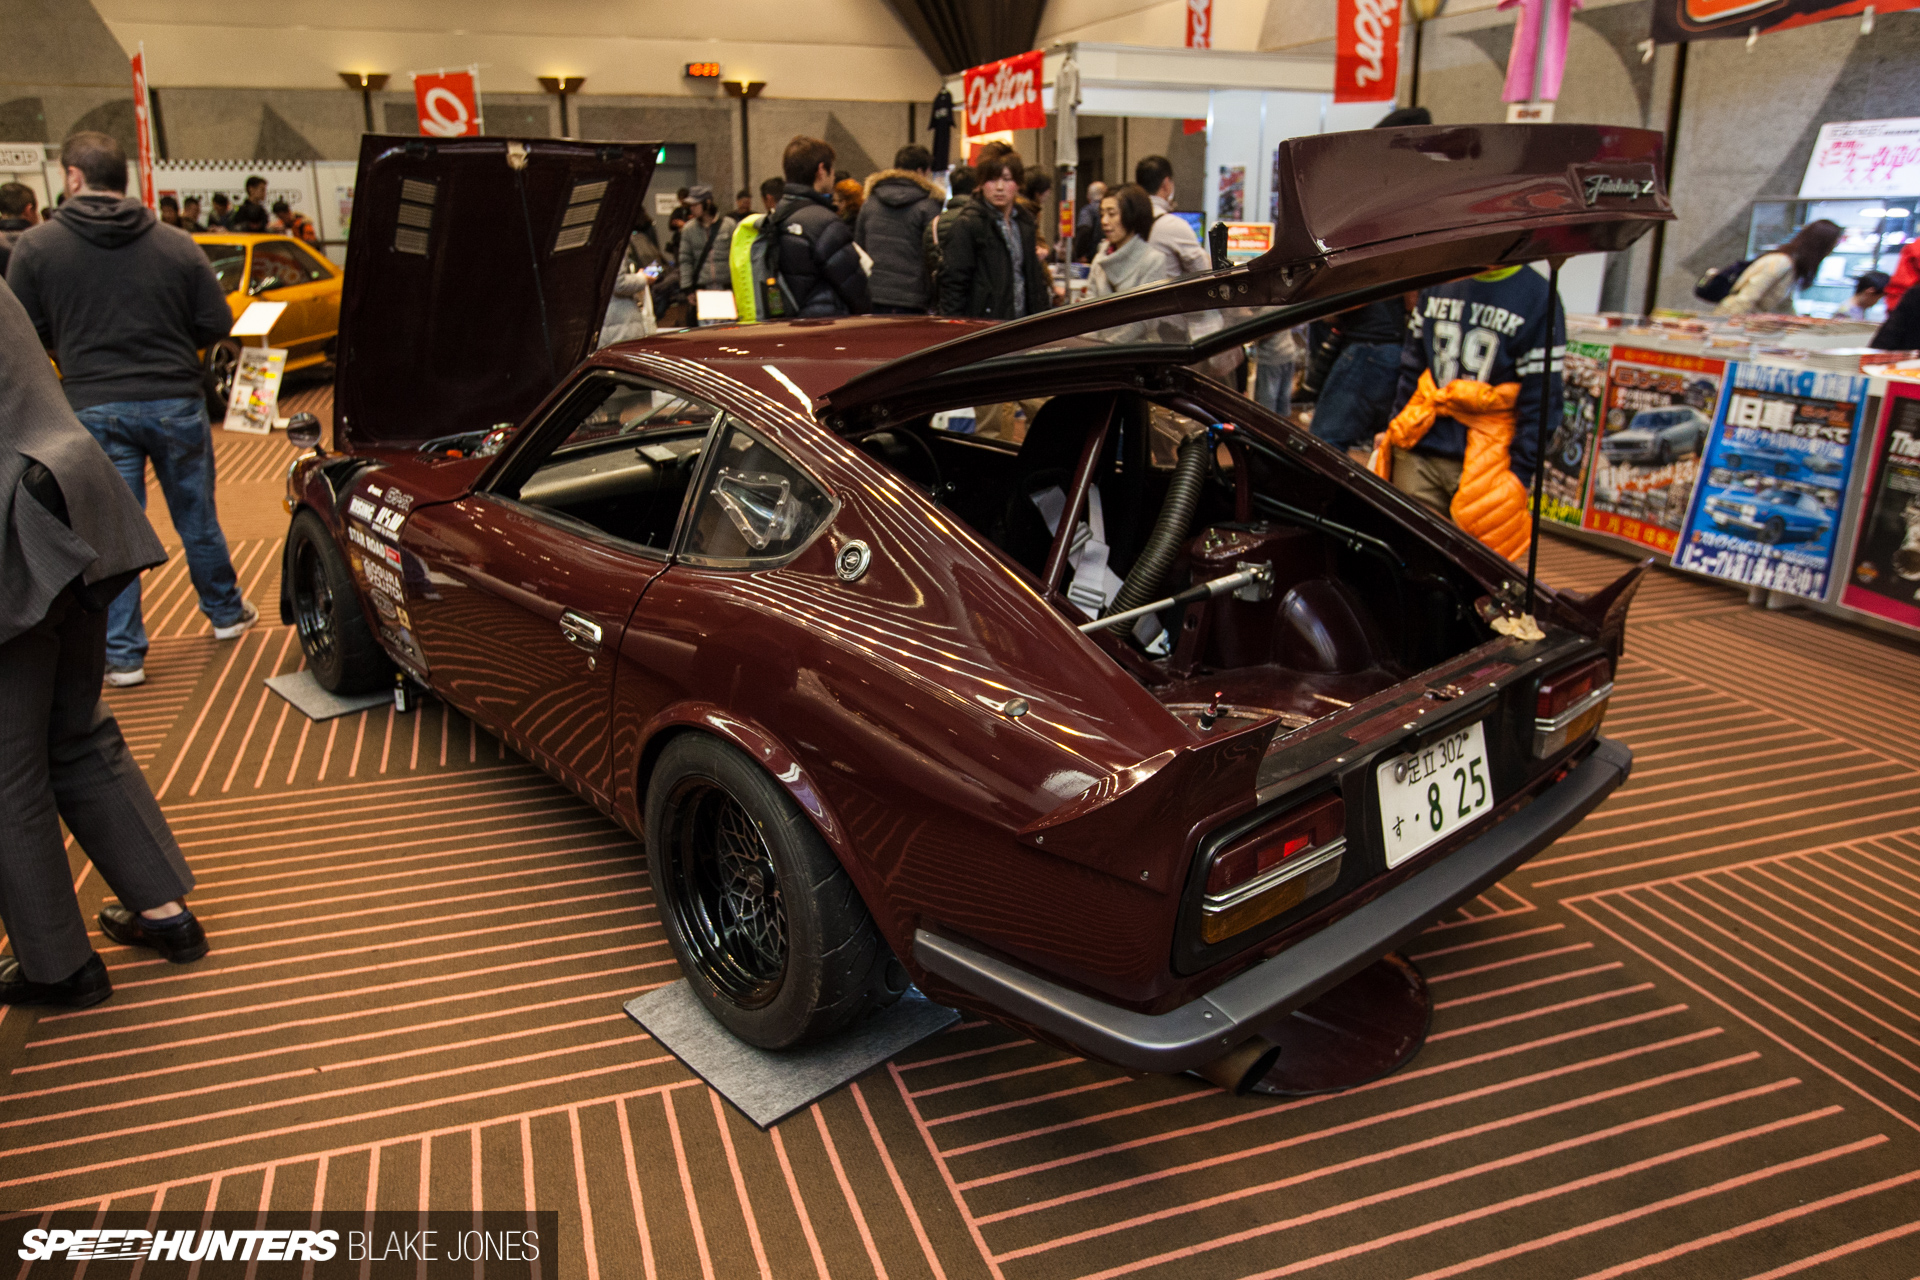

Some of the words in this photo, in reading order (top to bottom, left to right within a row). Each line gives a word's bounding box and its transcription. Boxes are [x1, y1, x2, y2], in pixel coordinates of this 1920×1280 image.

[968, 63, 1037, 133] Option
[1641, 180, 1656, 194] Z
[1424, 296, 1465, 321] NEW
[1469, 302, 1525, 337] YORK
[1433, 320, 1500, 388] 89
[348, 526, 367, 548] STAR
[365, 535, 386, 559] ROAD
[1407, 750, 1437, 786] 足立
[1438, 734, 1464, 768] 302
[1392, 816, 1405, 841] す
